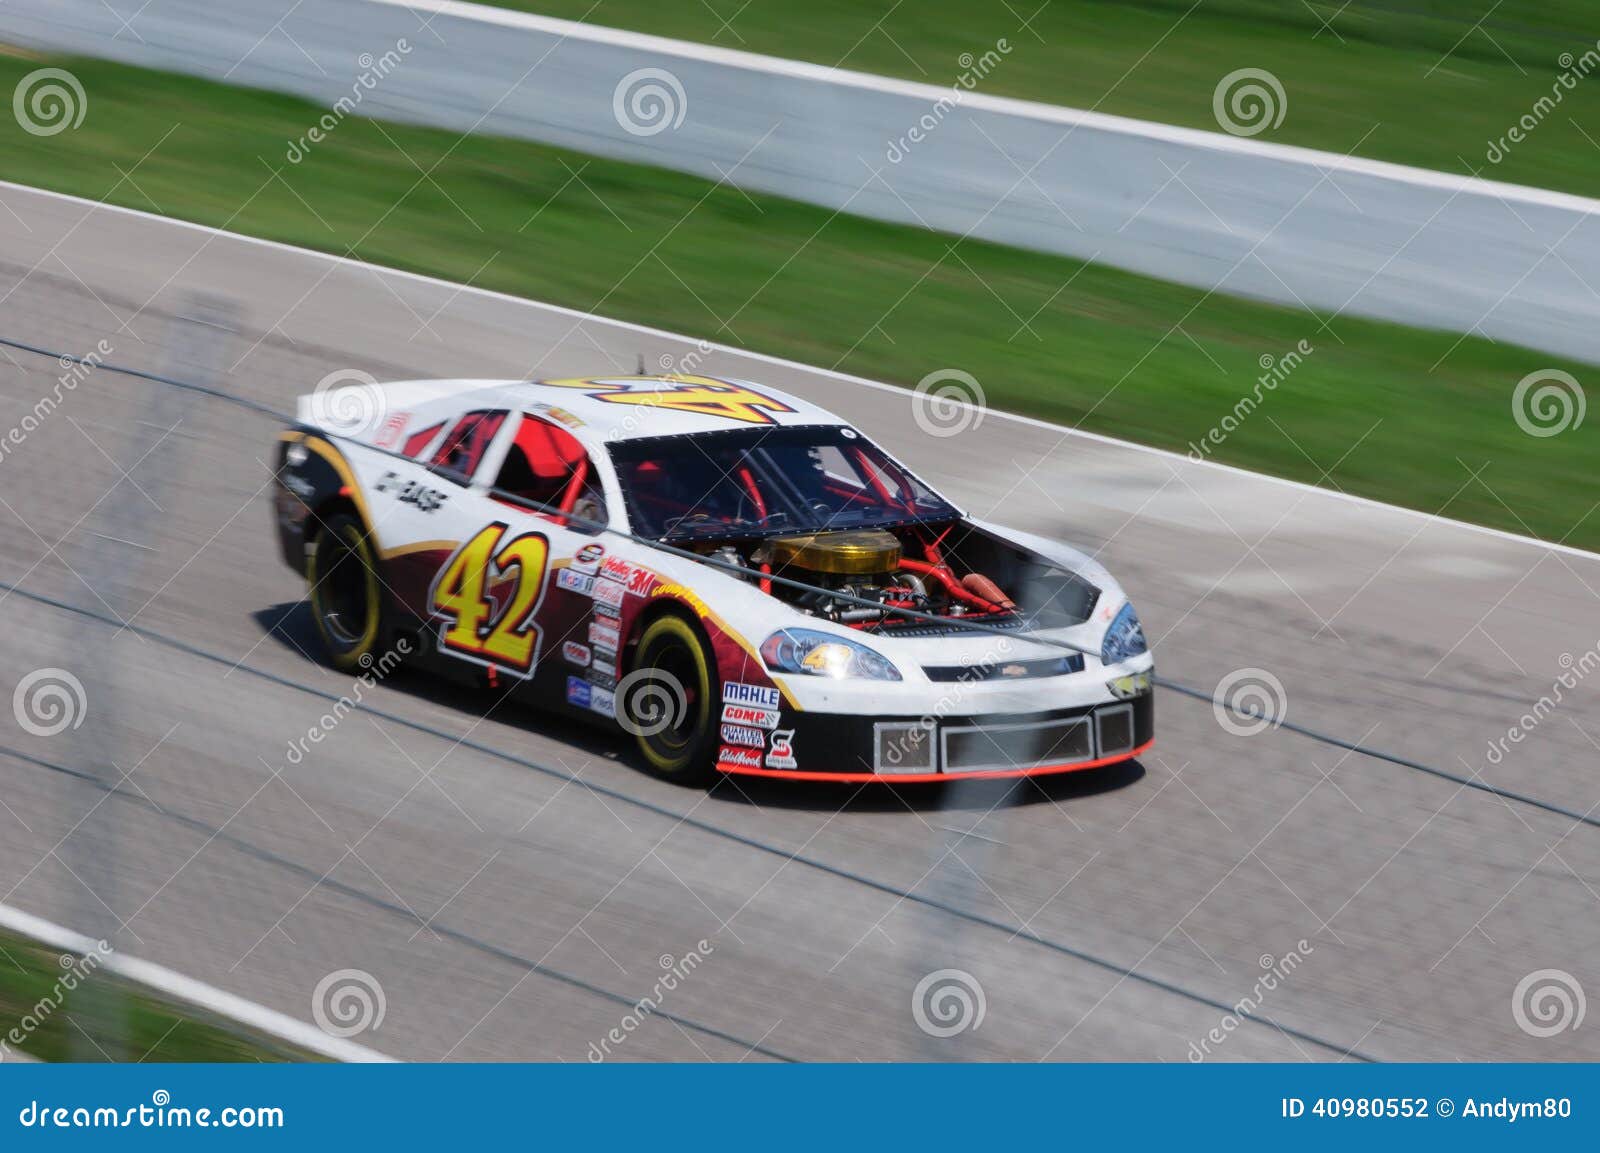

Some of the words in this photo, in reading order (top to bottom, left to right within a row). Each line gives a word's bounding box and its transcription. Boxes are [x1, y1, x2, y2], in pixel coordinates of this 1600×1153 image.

[628, 568, 656, 594] 3M
[431, 520, 550, 674] 42
[724, 683, 779, 705] MAHLE
[725, 707, 766, 723] COMP
